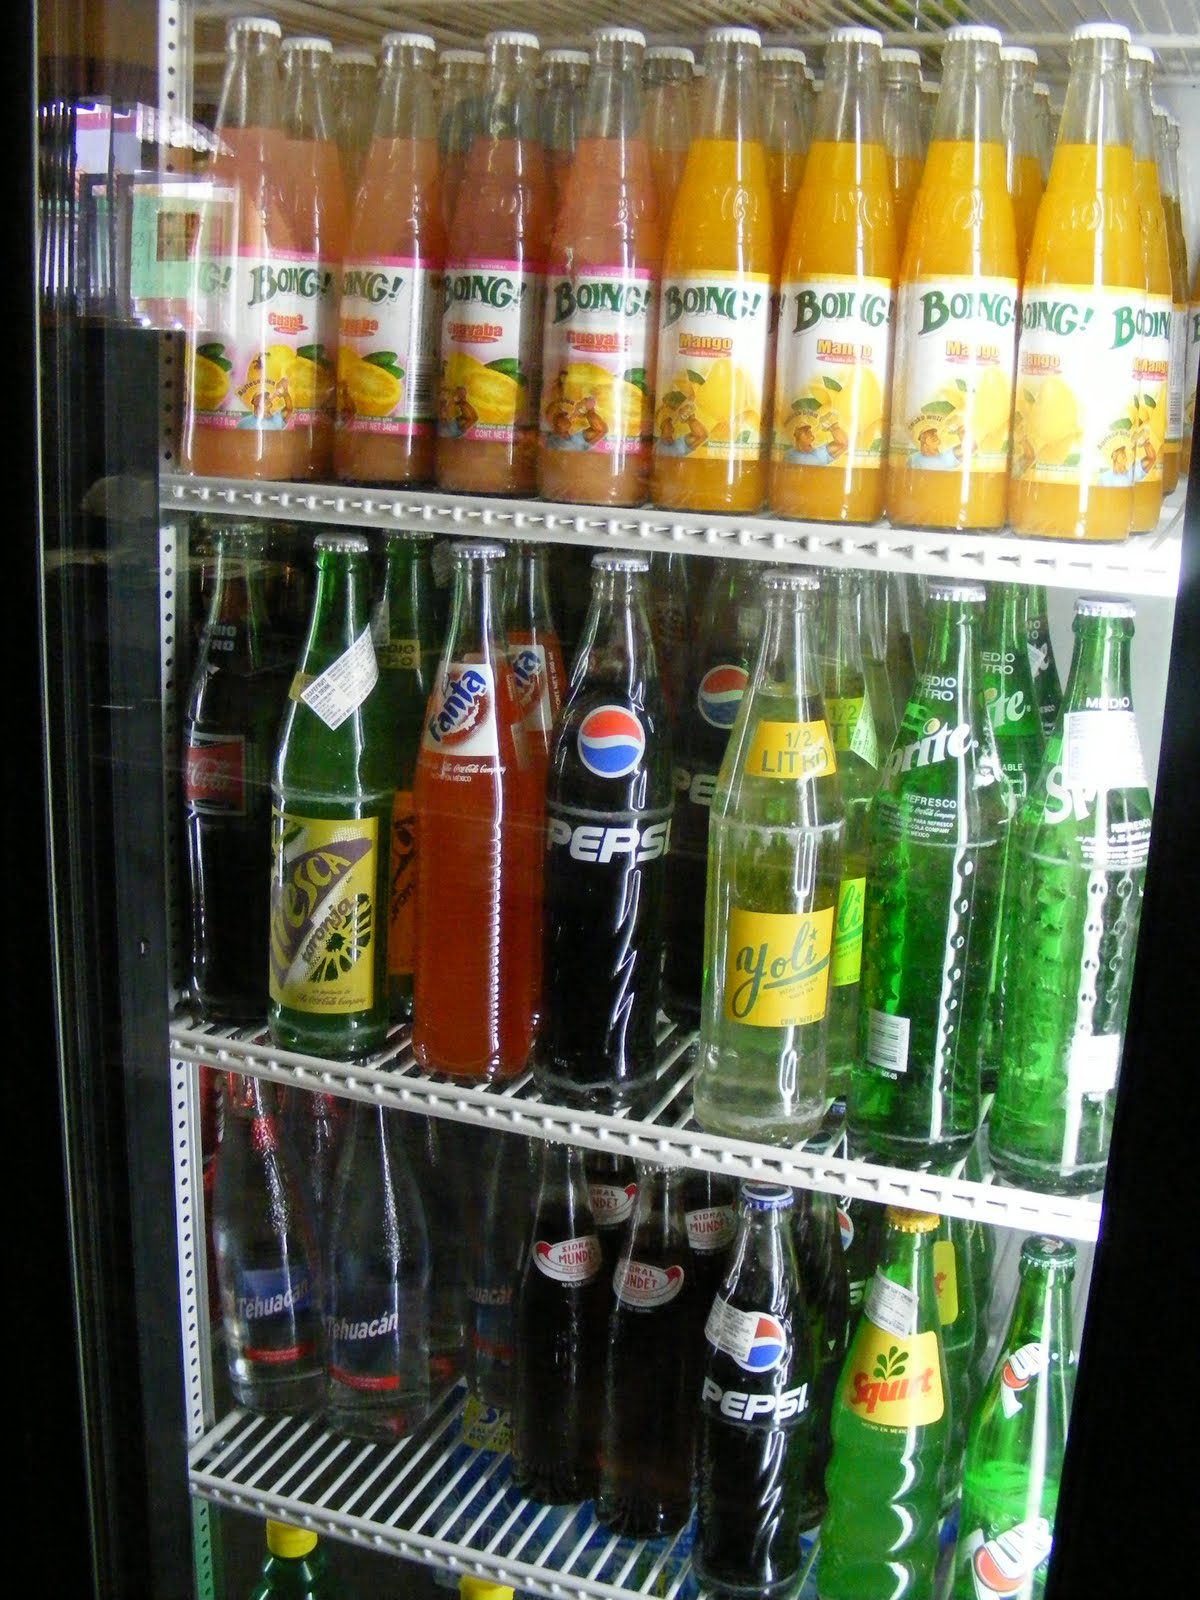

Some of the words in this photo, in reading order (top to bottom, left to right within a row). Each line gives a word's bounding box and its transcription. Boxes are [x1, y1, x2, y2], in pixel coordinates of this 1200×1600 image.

[248, 265, 332, 306] BOING!
[553, 282, 651, 324] BOING!
[663, 286, 762, 329] BOING!
[679, 333, 733, 351] Mango
[981, 652, 1016, 662] EDIO
[786, 730, 813, 748] 1/2
[762, 749, 829, 773] LITRO
[328, 1311, 398, 1341] Tehuacán
[702, 1376, 808, 1422] PEPSI
[854, 1367, 934, 1414] Squirt
